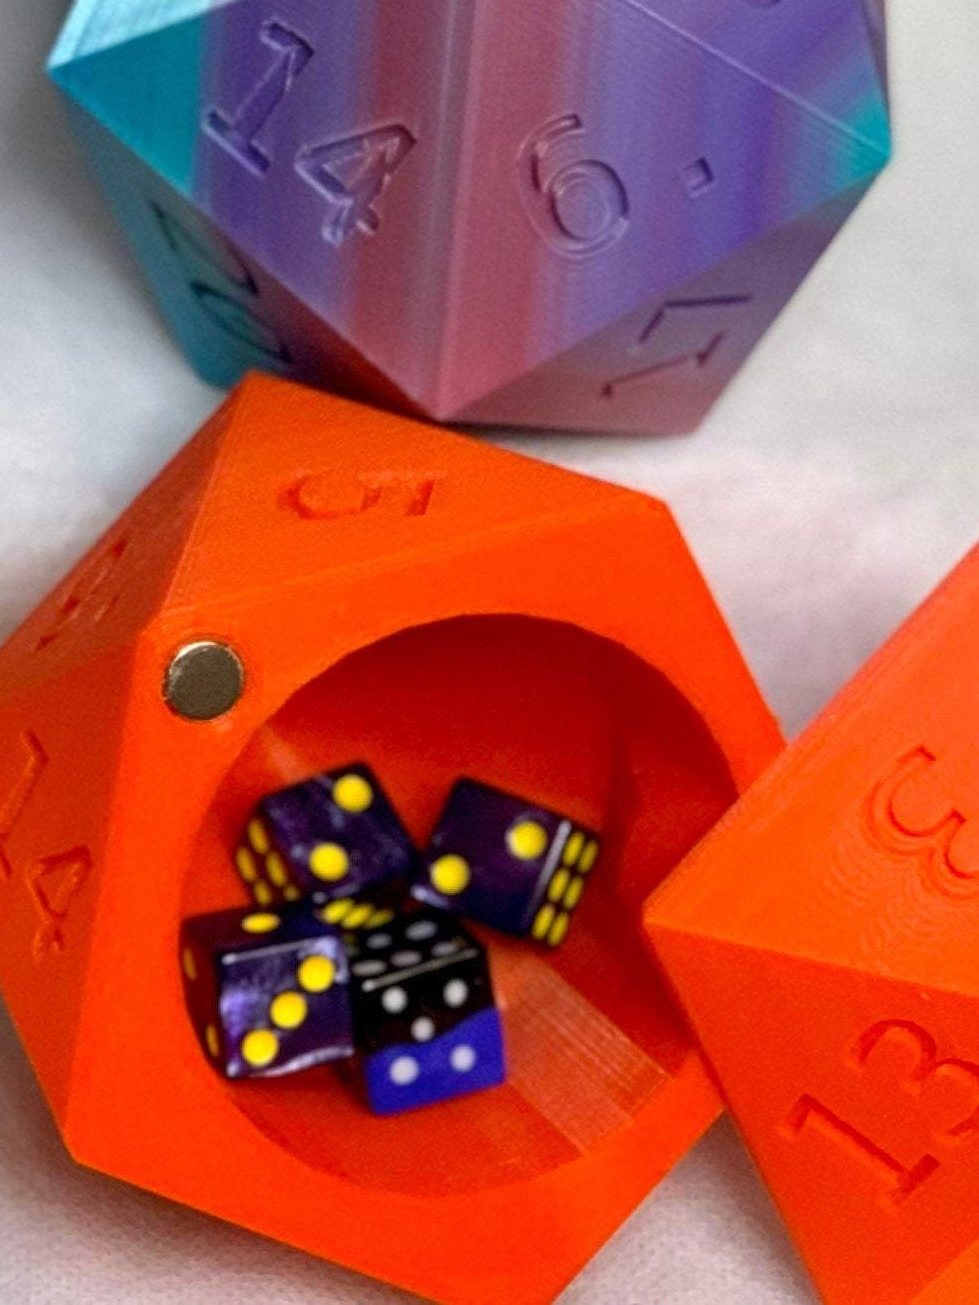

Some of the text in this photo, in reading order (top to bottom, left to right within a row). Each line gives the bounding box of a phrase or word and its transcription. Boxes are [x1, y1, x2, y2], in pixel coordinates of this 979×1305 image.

[202, 19, 417, 247] 14
[278, 470, 445, 521] 5
[867, 746, 979, 899] 3
[778, 1018, 979, 1209] 13
